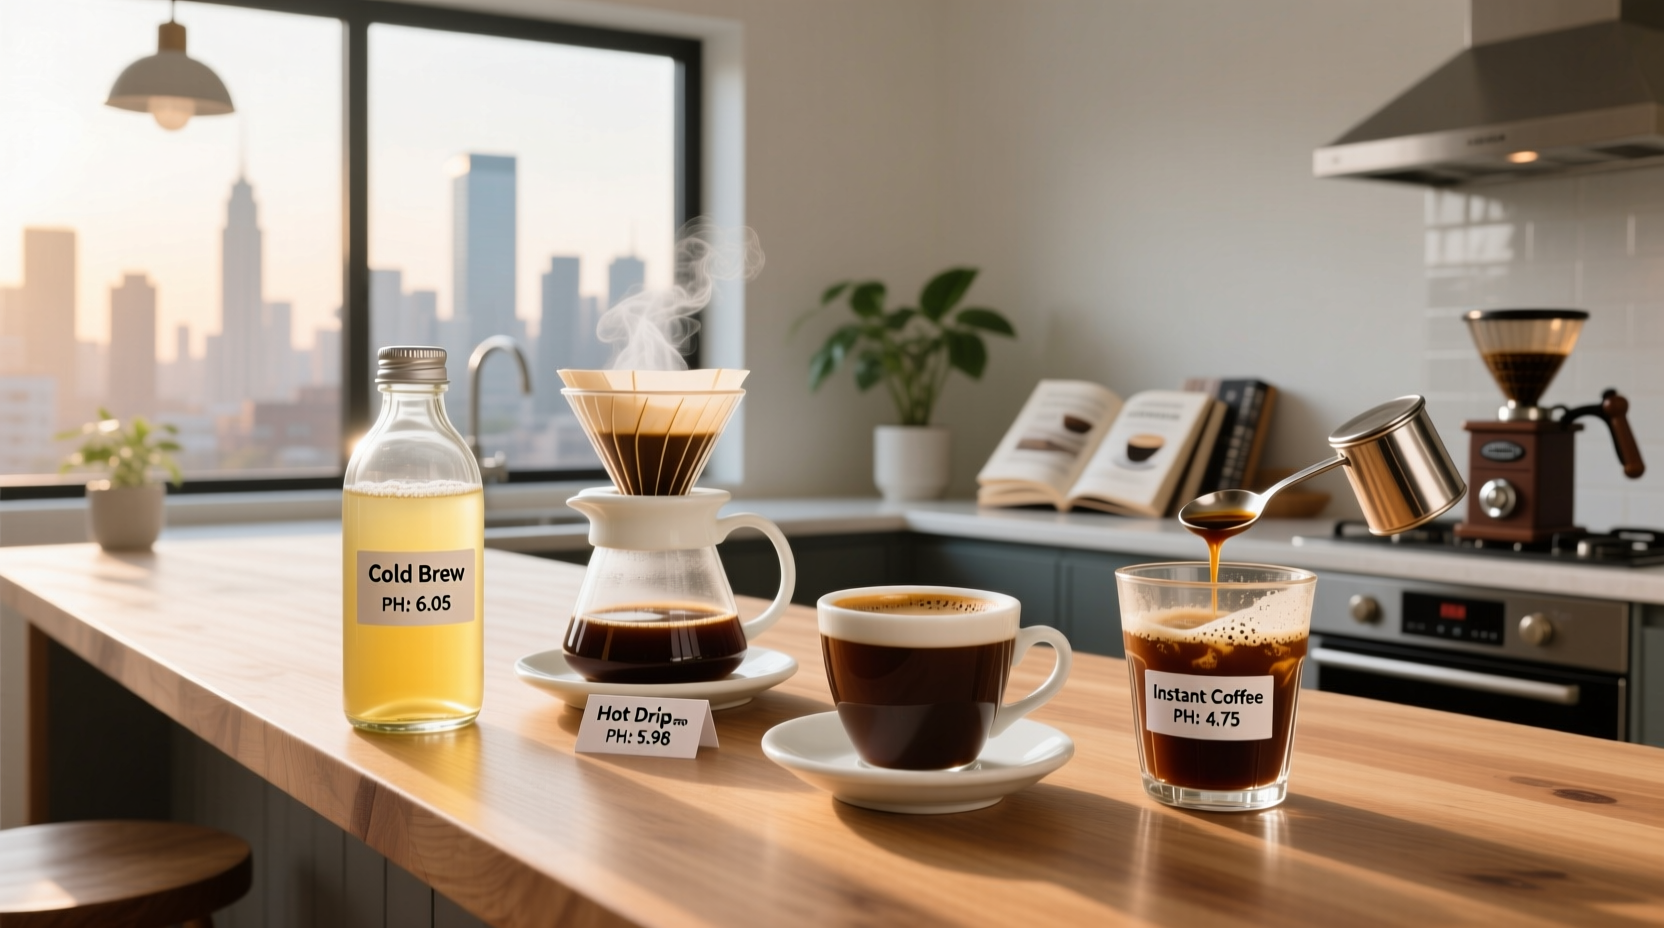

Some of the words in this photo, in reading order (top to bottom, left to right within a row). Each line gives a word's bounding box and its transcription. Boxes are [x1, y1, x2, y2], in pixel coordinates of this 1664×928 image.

[368, 563, 412, 583] Cold
[418, 564, 465, 583] Brew
[382, 596, 411, 613] PH:
[416, 595, 451, 612] 6.05
[1153, 684, 1207, 704] Instant
[1211, 689, 1264, 705] Coffee
[597, 705, 631, 722] Hot
[1174, 708, 1200, 725] PH:
[1205, 711, 1240, 727] 4.75
[605, 728, 633, 744] PH:
[637, 730, 671, 746] 5.98
